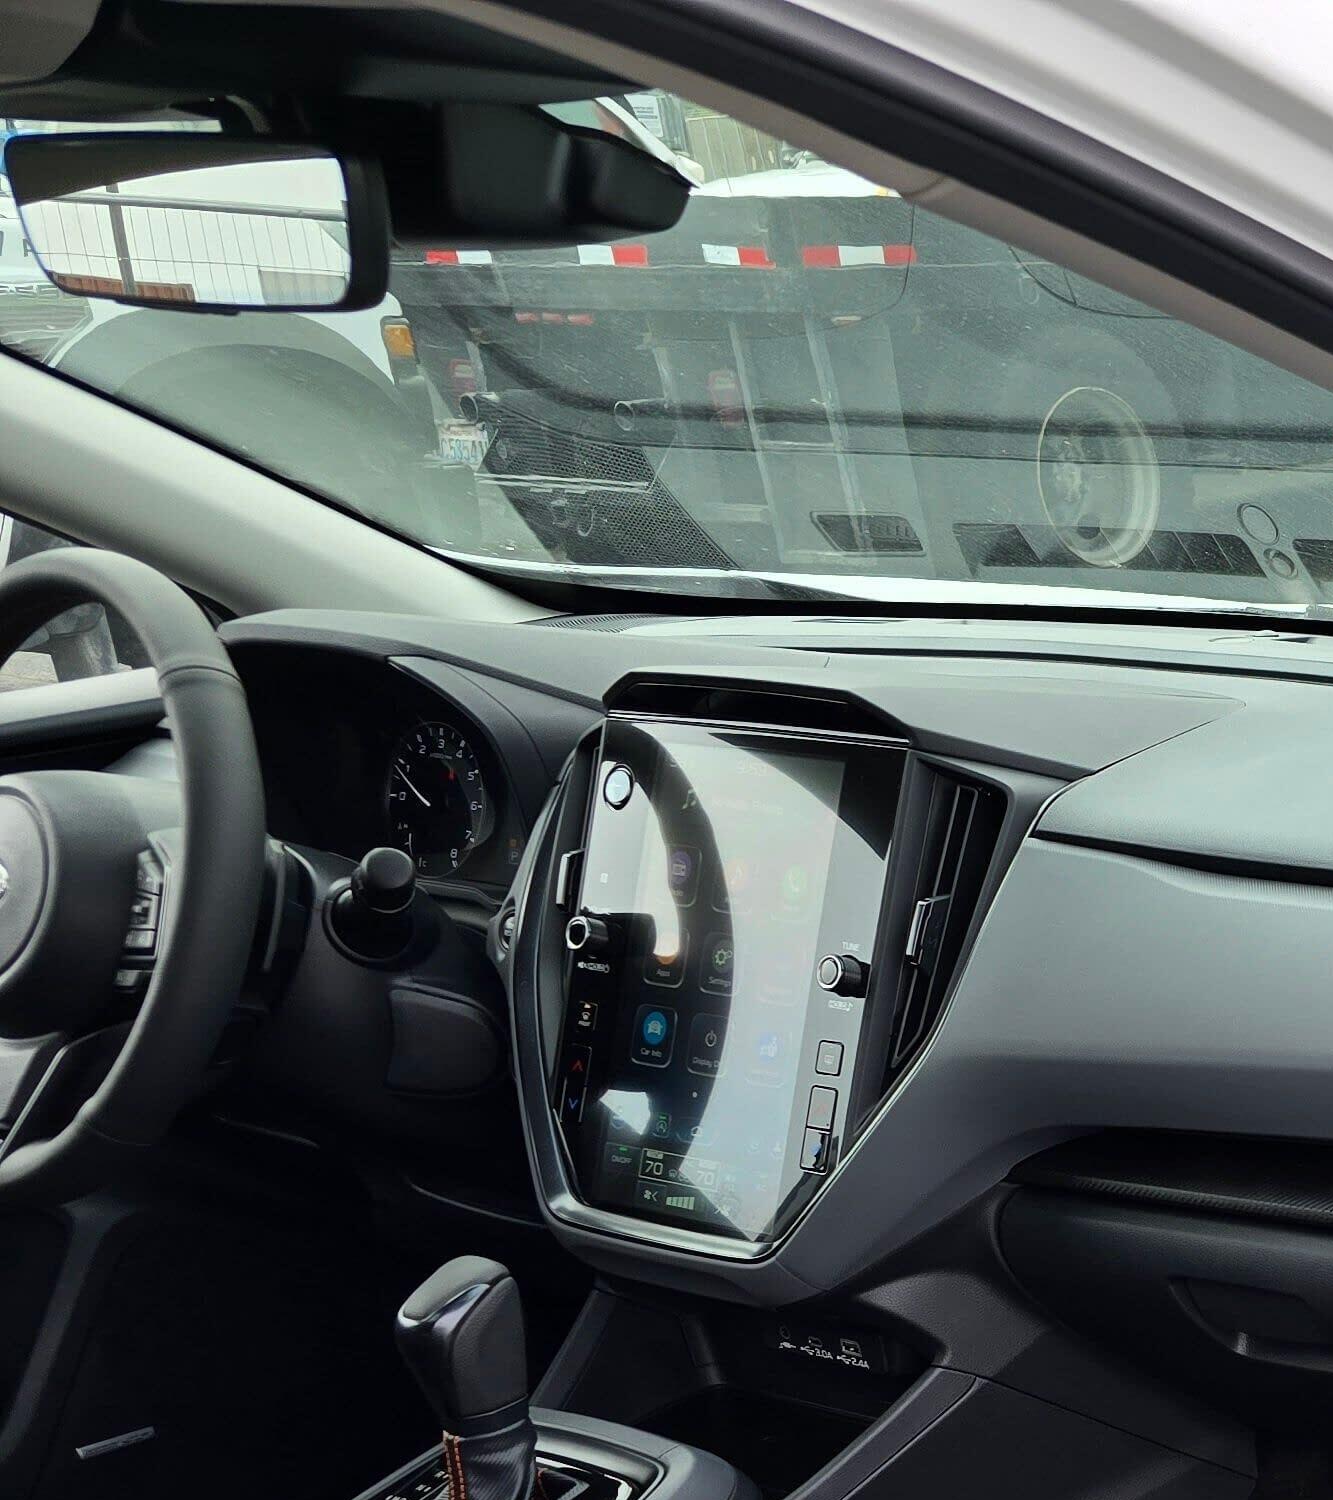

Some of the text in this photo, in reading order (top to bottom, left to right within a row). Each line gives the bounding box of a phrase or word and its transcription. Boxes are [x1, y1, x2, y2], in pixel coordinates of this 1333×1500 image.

[842, 941, 860, 952] TUNE
[645, 1160, 664, 1176] 70
[697, 1170, 715, 1186] 70
